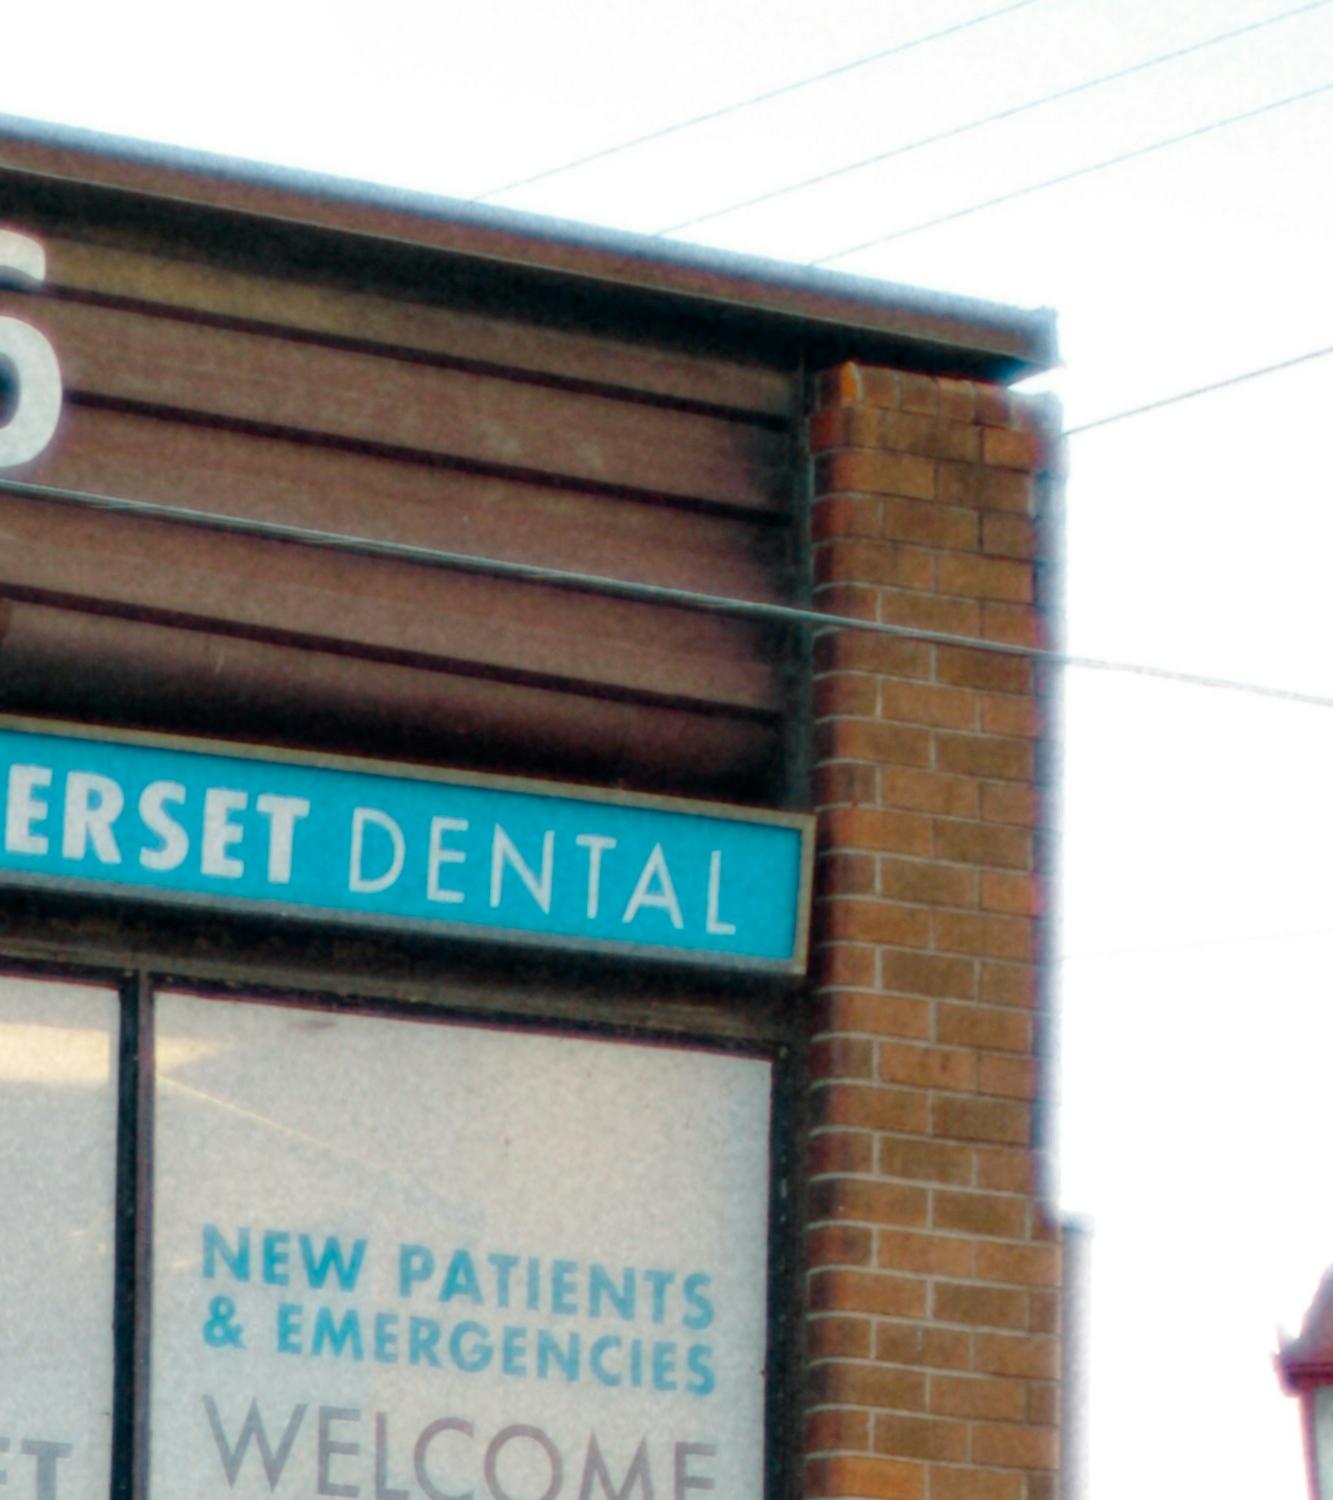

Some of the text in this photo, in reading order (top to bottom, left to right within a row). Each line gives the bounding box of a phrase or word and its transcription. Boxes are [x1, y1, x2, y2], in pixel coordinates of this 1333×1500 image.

[347, 807, 739, 938] DENTAL
[200, 1221, 717, 1334] NEW PATIENTS
[200, 1292, 717, 1397] & EMERGENCIES
